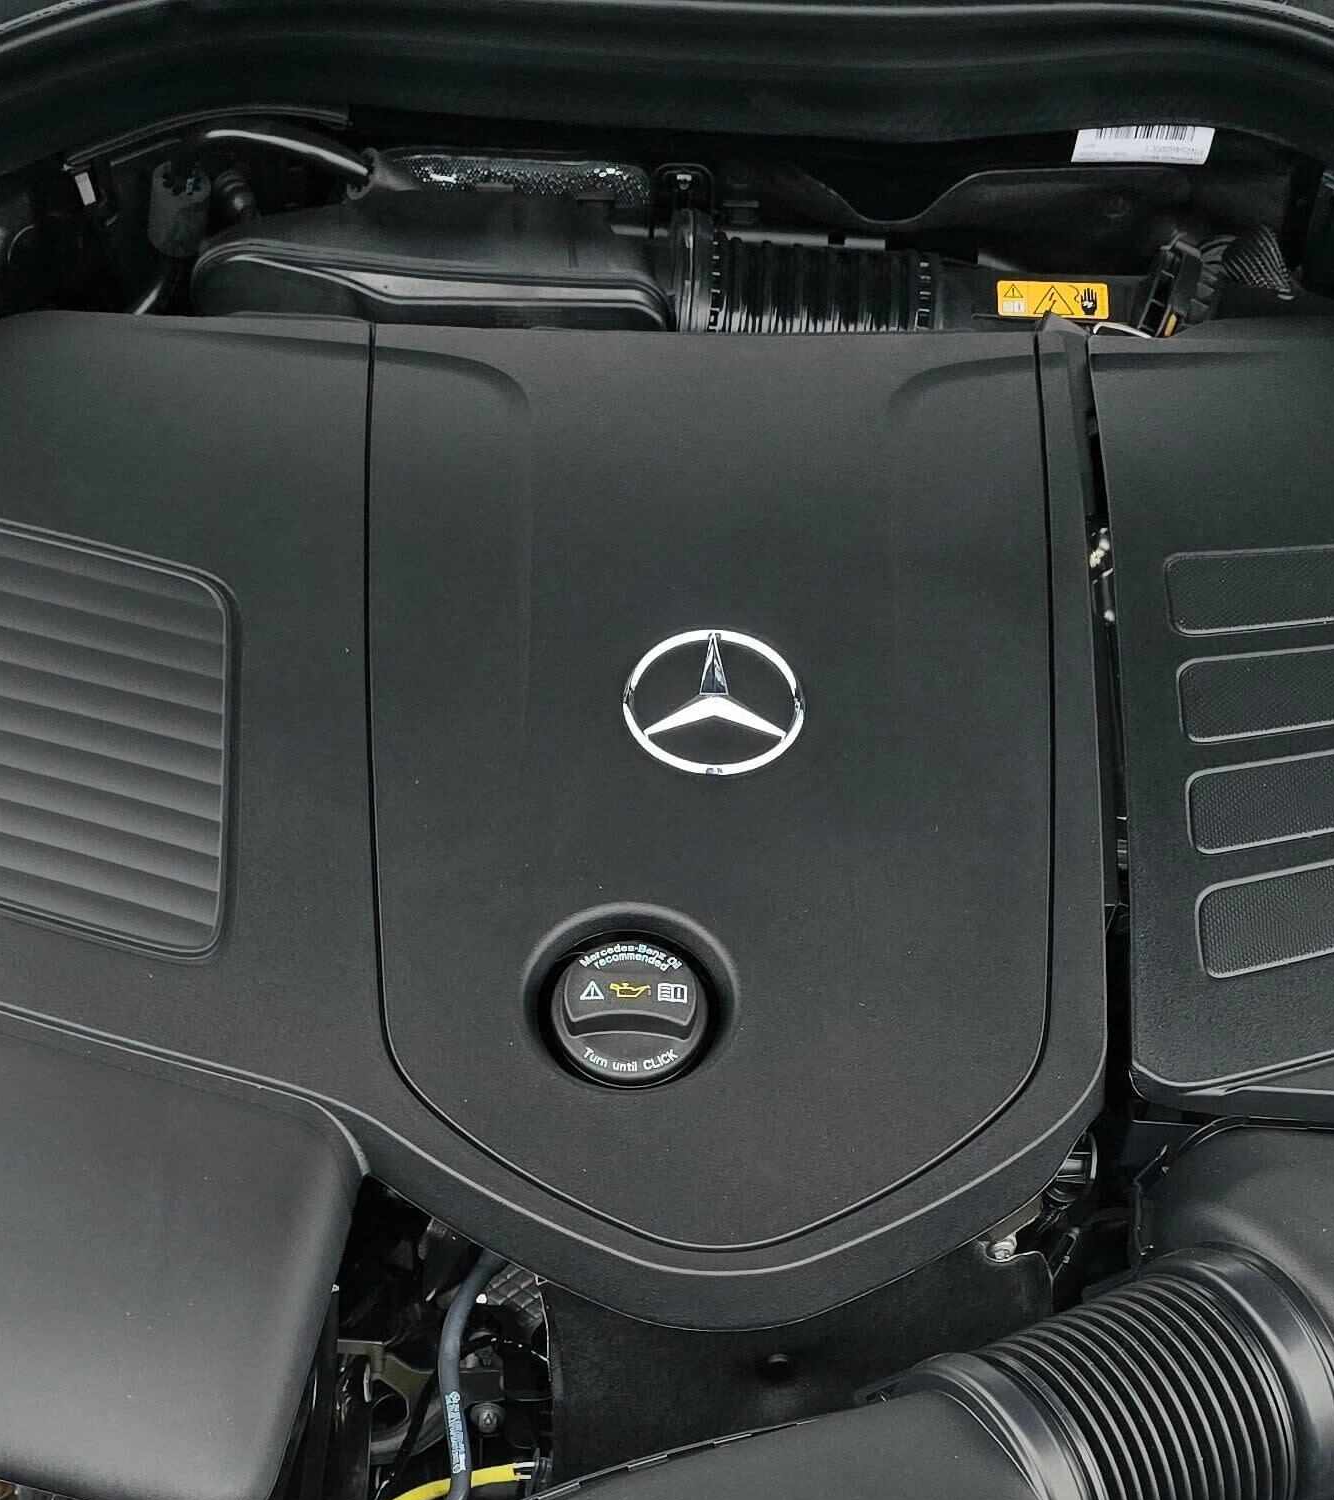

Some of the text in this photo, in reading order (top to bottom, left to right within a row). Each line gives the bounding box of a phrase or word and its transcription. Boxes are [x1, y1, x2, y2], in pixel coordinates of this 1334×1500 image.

[578, 943, 683, 970] Mercedes-Benz Oil
[593, 952, 671, 972] recommended
[583, 1046, 679, 1072] Turn until CLICK
